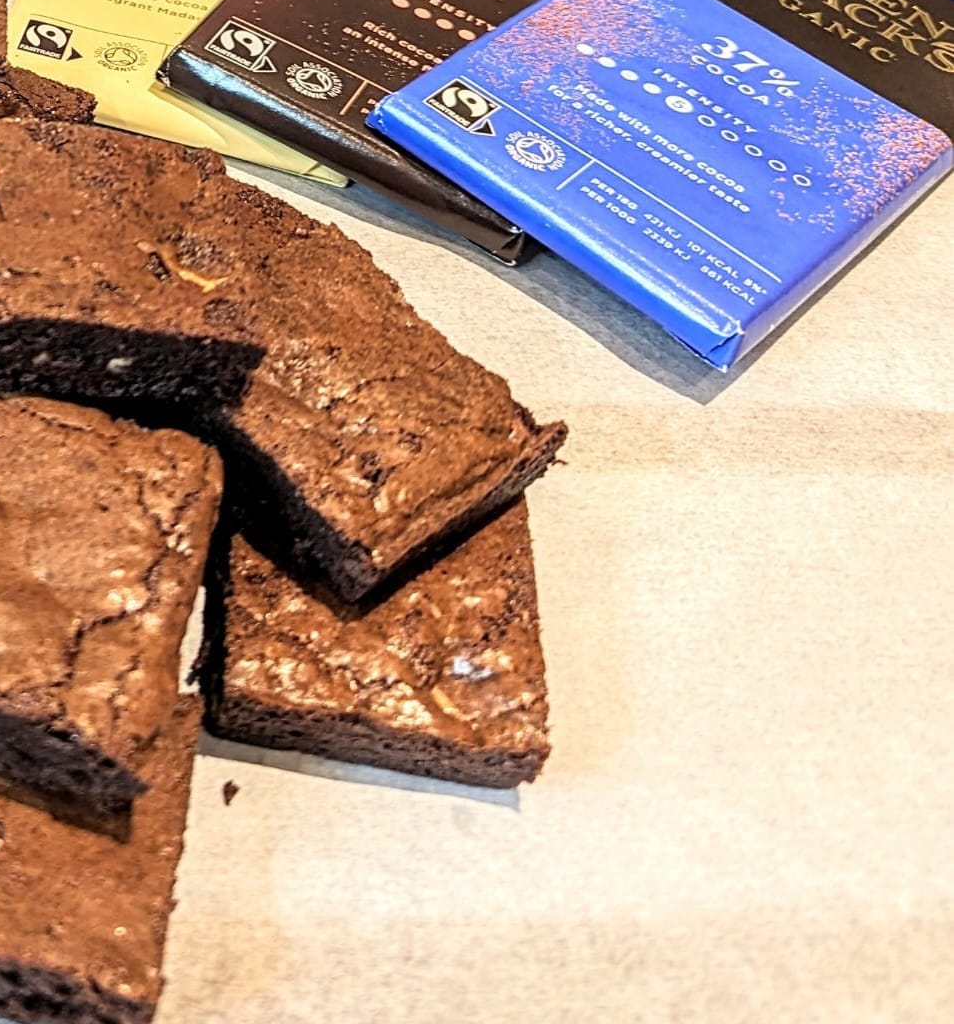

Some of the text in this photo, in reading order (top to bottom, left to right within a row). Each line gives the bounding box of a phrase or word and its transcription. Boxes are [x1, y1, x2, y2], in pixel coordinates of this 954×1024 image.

[20, 43, 62, 59] FAIRTRADE
[209, 44, 252, 67] FAIRTRADE
[342, 26, 419, 67] an intense
[362, 21, 444, 64] Rich cocoa
[701, 36, 801, 97] 37%
[652, 68, 758, 134] INTENSITY
[691, 54, 769, 106] COCOA
[429, 98, 471, 127] FAIRTRADE
[575, 84, 745, 193] Made with more cocoa
[548, 85, 751, 213] for a richer, creamier taste
[580, 186, 605, 203] PER
[605, 202, 637, 225] 100G
[642, 227, 673, 249] 2339
[674, 248, 691, 261] KJ
[722, 279, 757, 306] KCAL
[590, 177, 616, 196] PER
[643, 213, 664, 227] 421
[664, 226, 682, 240] KJ
[686, 241, 705, 256] 101
[706, 254, 739, 279] KCAL
